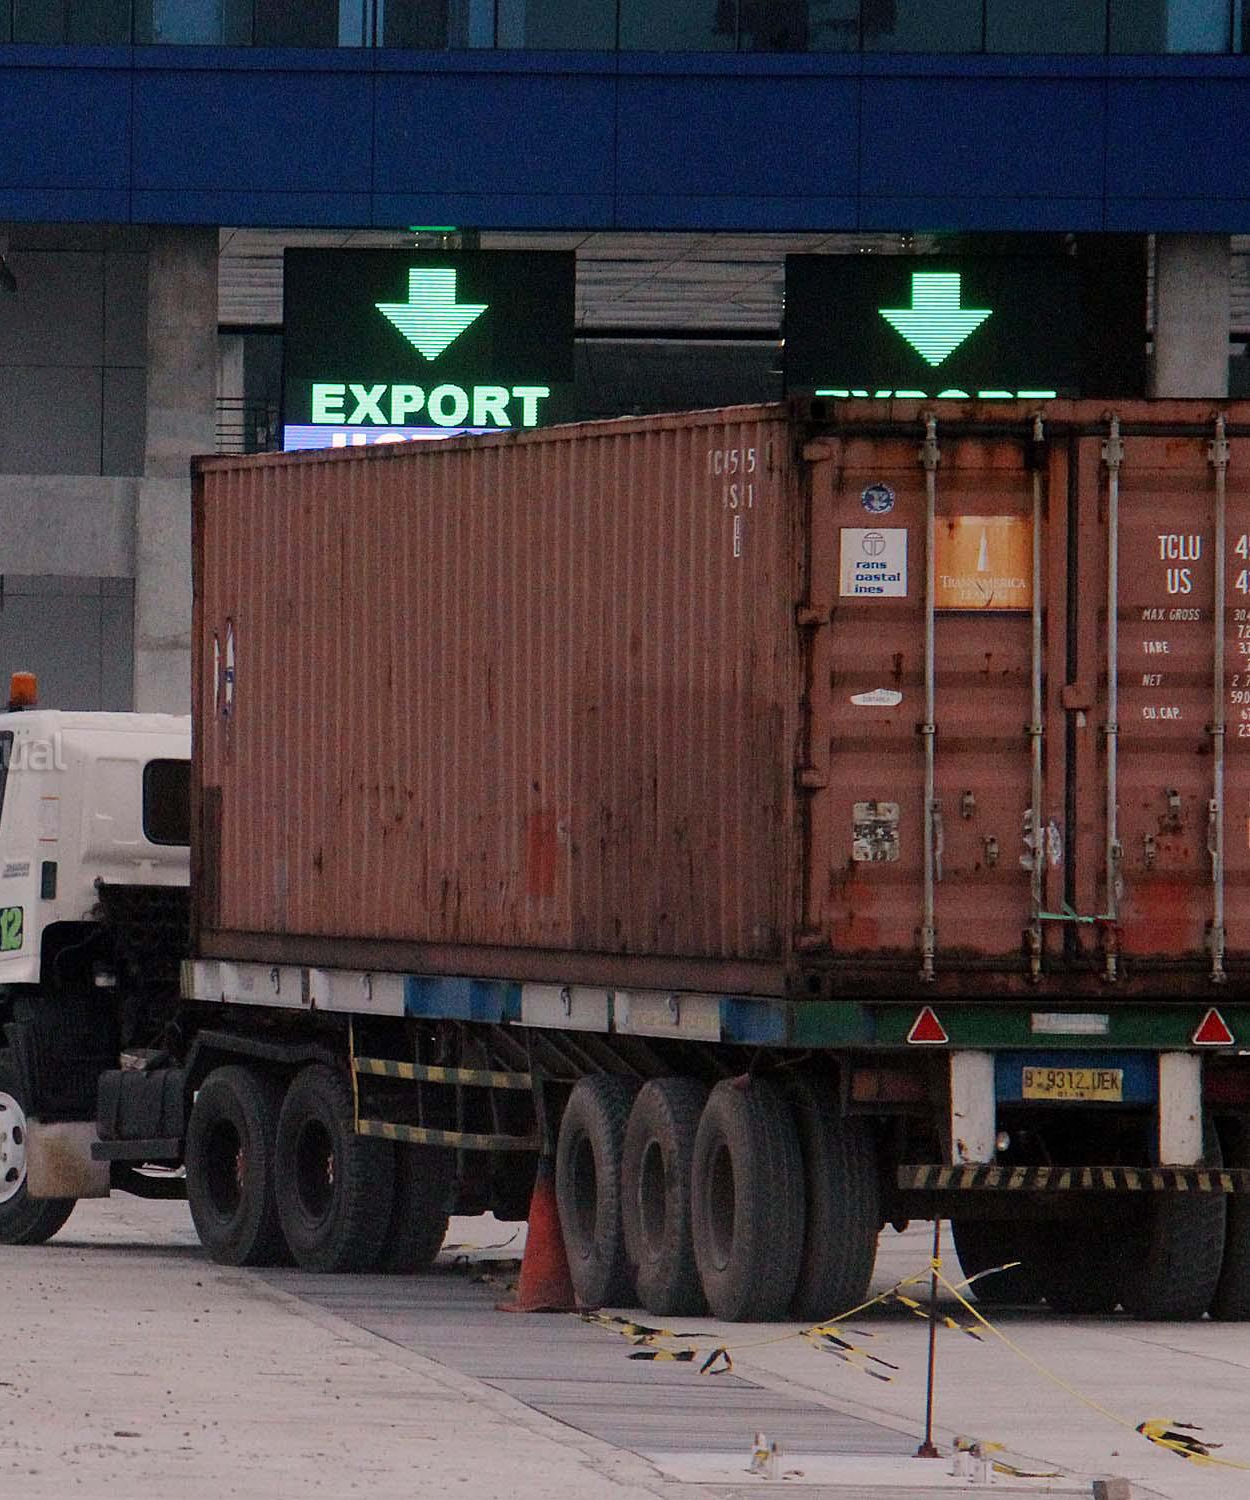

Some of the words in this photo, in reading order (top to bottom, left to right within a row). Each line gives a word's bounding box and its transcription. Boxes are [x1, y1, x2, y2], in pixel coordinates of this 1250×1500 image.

[311, 383, 550, 426] EXPORT
[1157, 534, 1201, 560] TCLU
[1166, 568, 1192, 594] US
[1142, 608, 1165, 621] MAX
[1169, 608, 1201, 621] GROSS
[1141, 674, 1163, 687] NET
